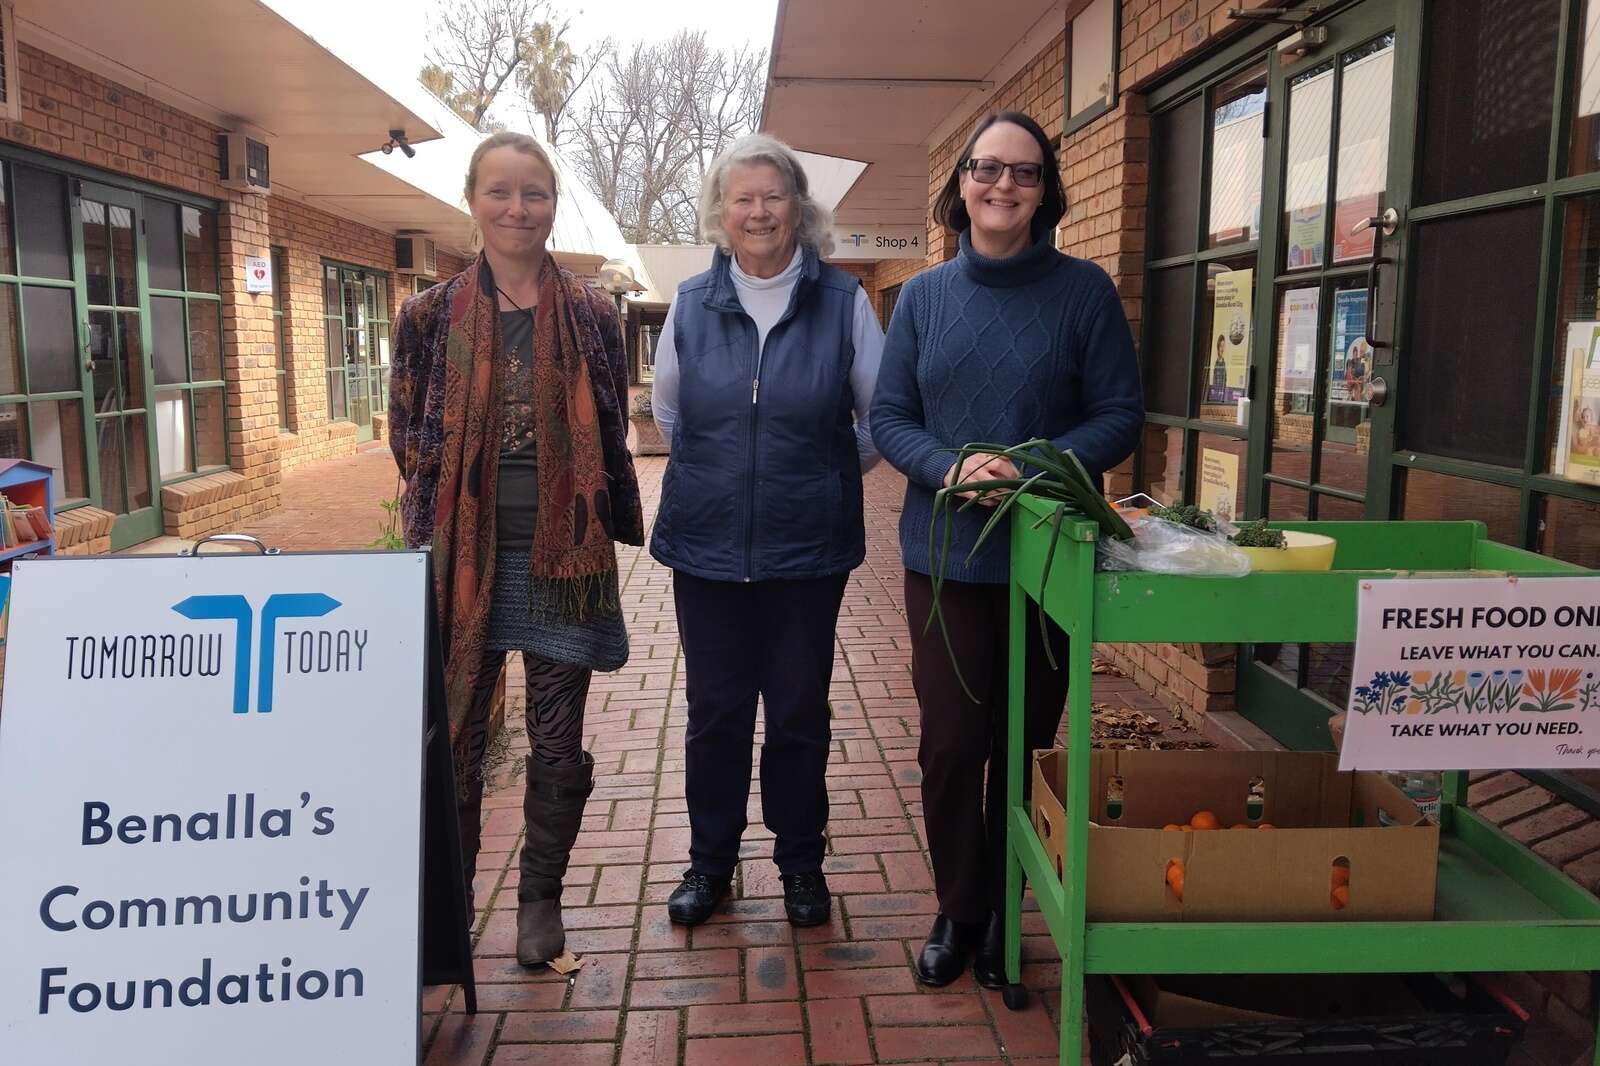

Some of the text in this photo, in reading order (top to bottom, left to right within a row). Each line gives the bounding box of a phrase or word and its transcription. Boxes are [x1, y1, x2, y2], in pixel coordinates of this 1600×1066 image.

[875, 236, 919, 249] Shop 4
[1382, 607, 1464, 630] FRESH
[1471, 606, 1547, 629] FOOD
[66, 629, 368, 680] TOMORROW TODAY
[1400, 643, 1600, 660] LEAVE WHAT YOU CAN.
[1390, 721, 1583, 737] TAKE WHAT YOU NEED.
[1555, 743, 1584, 756] Thank
[82, 791, 336, 846] Benalla’s
[39, 876, 370, 933] Community
[38, 957, 365, 1015] Foundation
